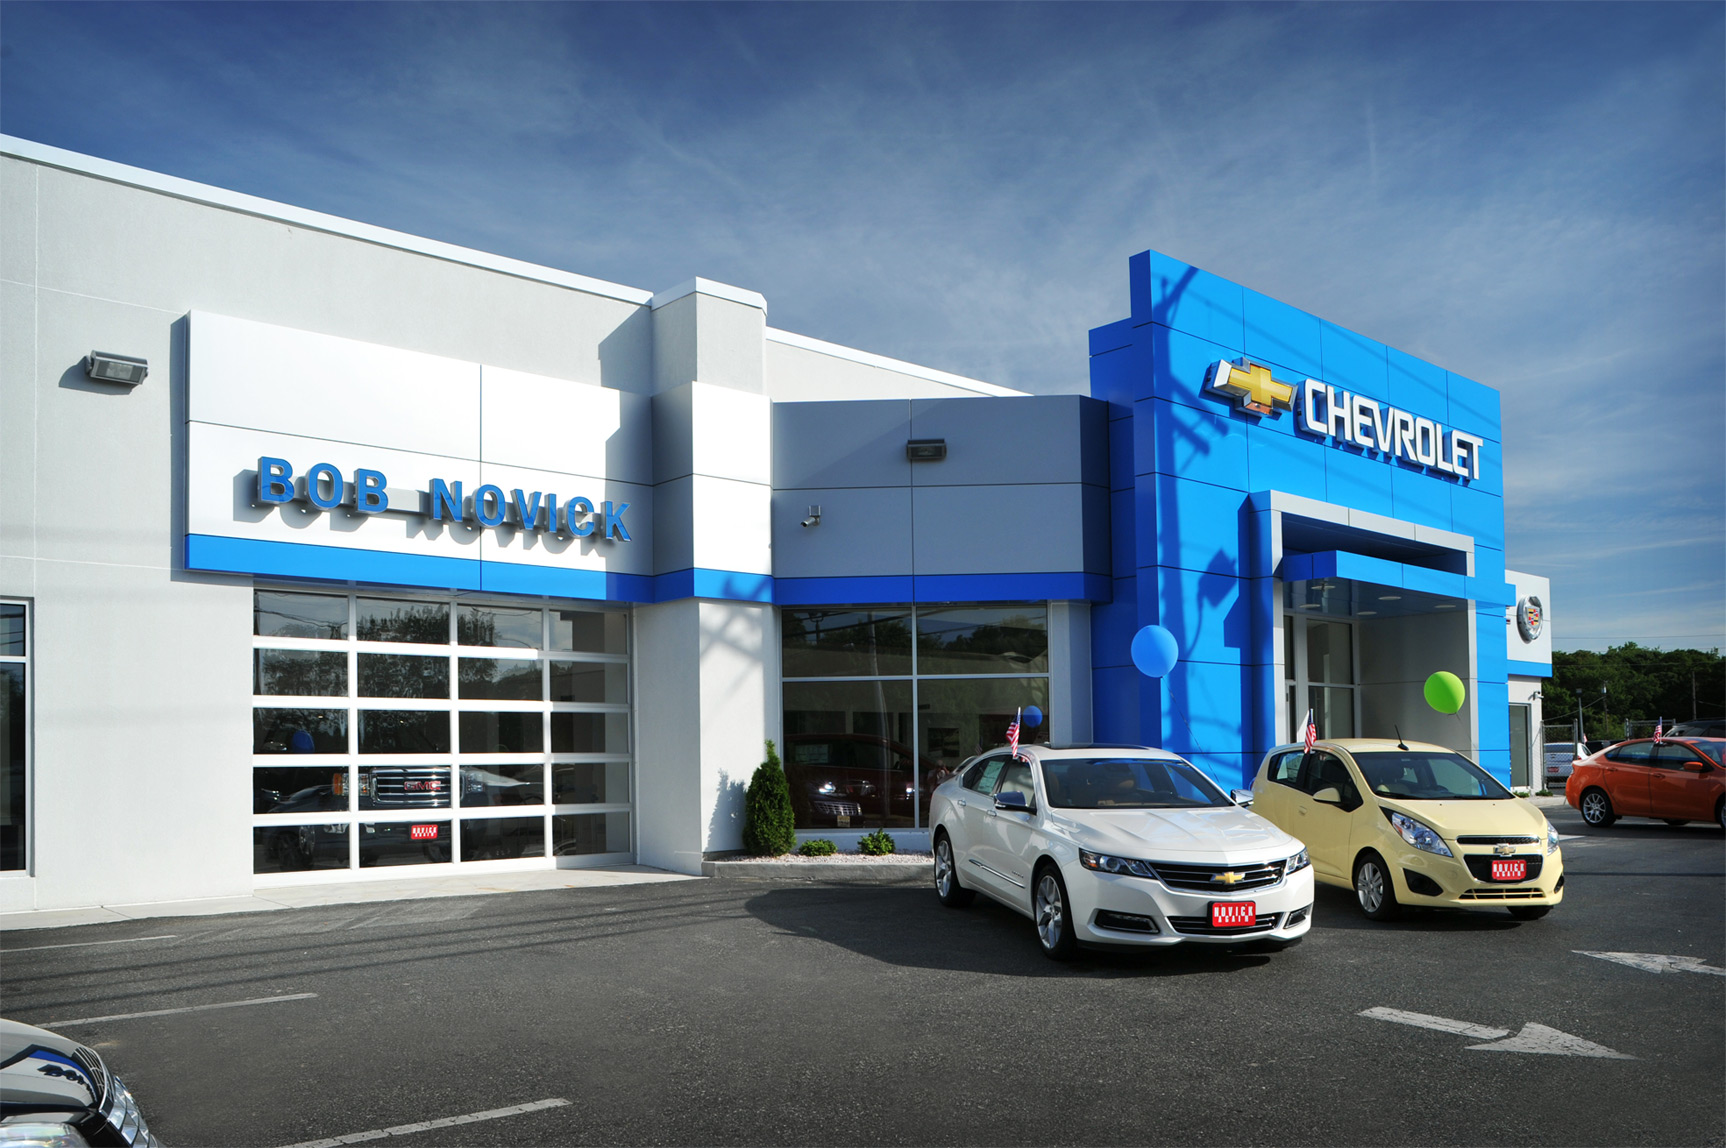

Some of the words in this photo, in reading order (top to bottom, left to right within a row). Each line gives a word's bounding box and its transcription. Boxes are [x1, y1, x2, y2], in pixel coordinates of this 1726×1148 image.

[1305, 378, 1484, 480] CHEVROLET
[257, 456, 388, 513] BOB
[429, 478, 631, 542] NOVICK
[404, 781, 441, 790] GMC
[1214, 906, 1253, 917] NOVICK
[1218, 915, 1249, 923] AGAIN
